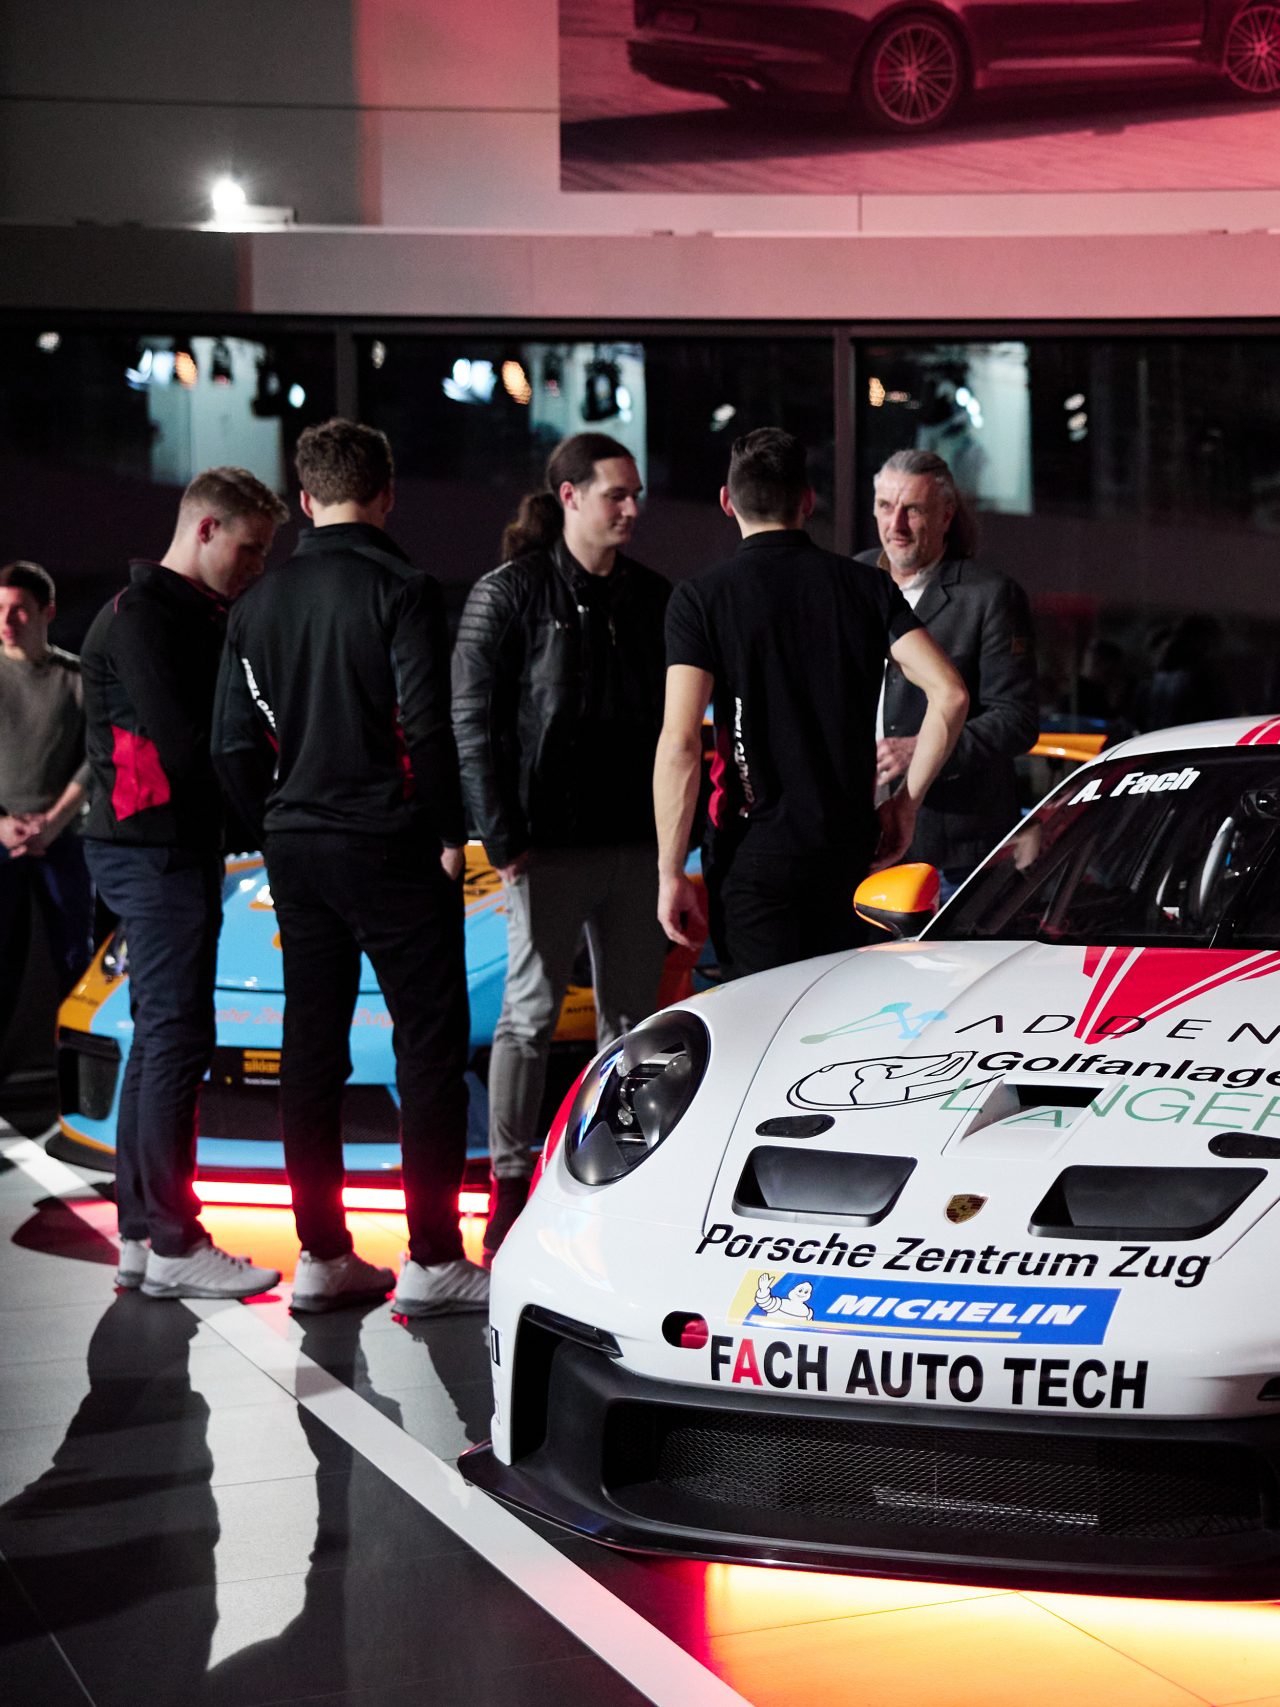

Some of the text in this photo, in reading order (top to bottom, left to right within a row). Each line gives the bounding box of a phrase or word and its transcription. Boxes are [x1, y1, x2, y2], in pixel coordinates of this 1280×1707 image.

[1067, 767, 1200, 806] A. Fach
[695, 1223, 1212, 1289] Porsche Zentrum Zug
[826, 1294, 1087, 1326] MICHELIN
[710, 1334, 1149, 1409] FACH AUTO TECH
